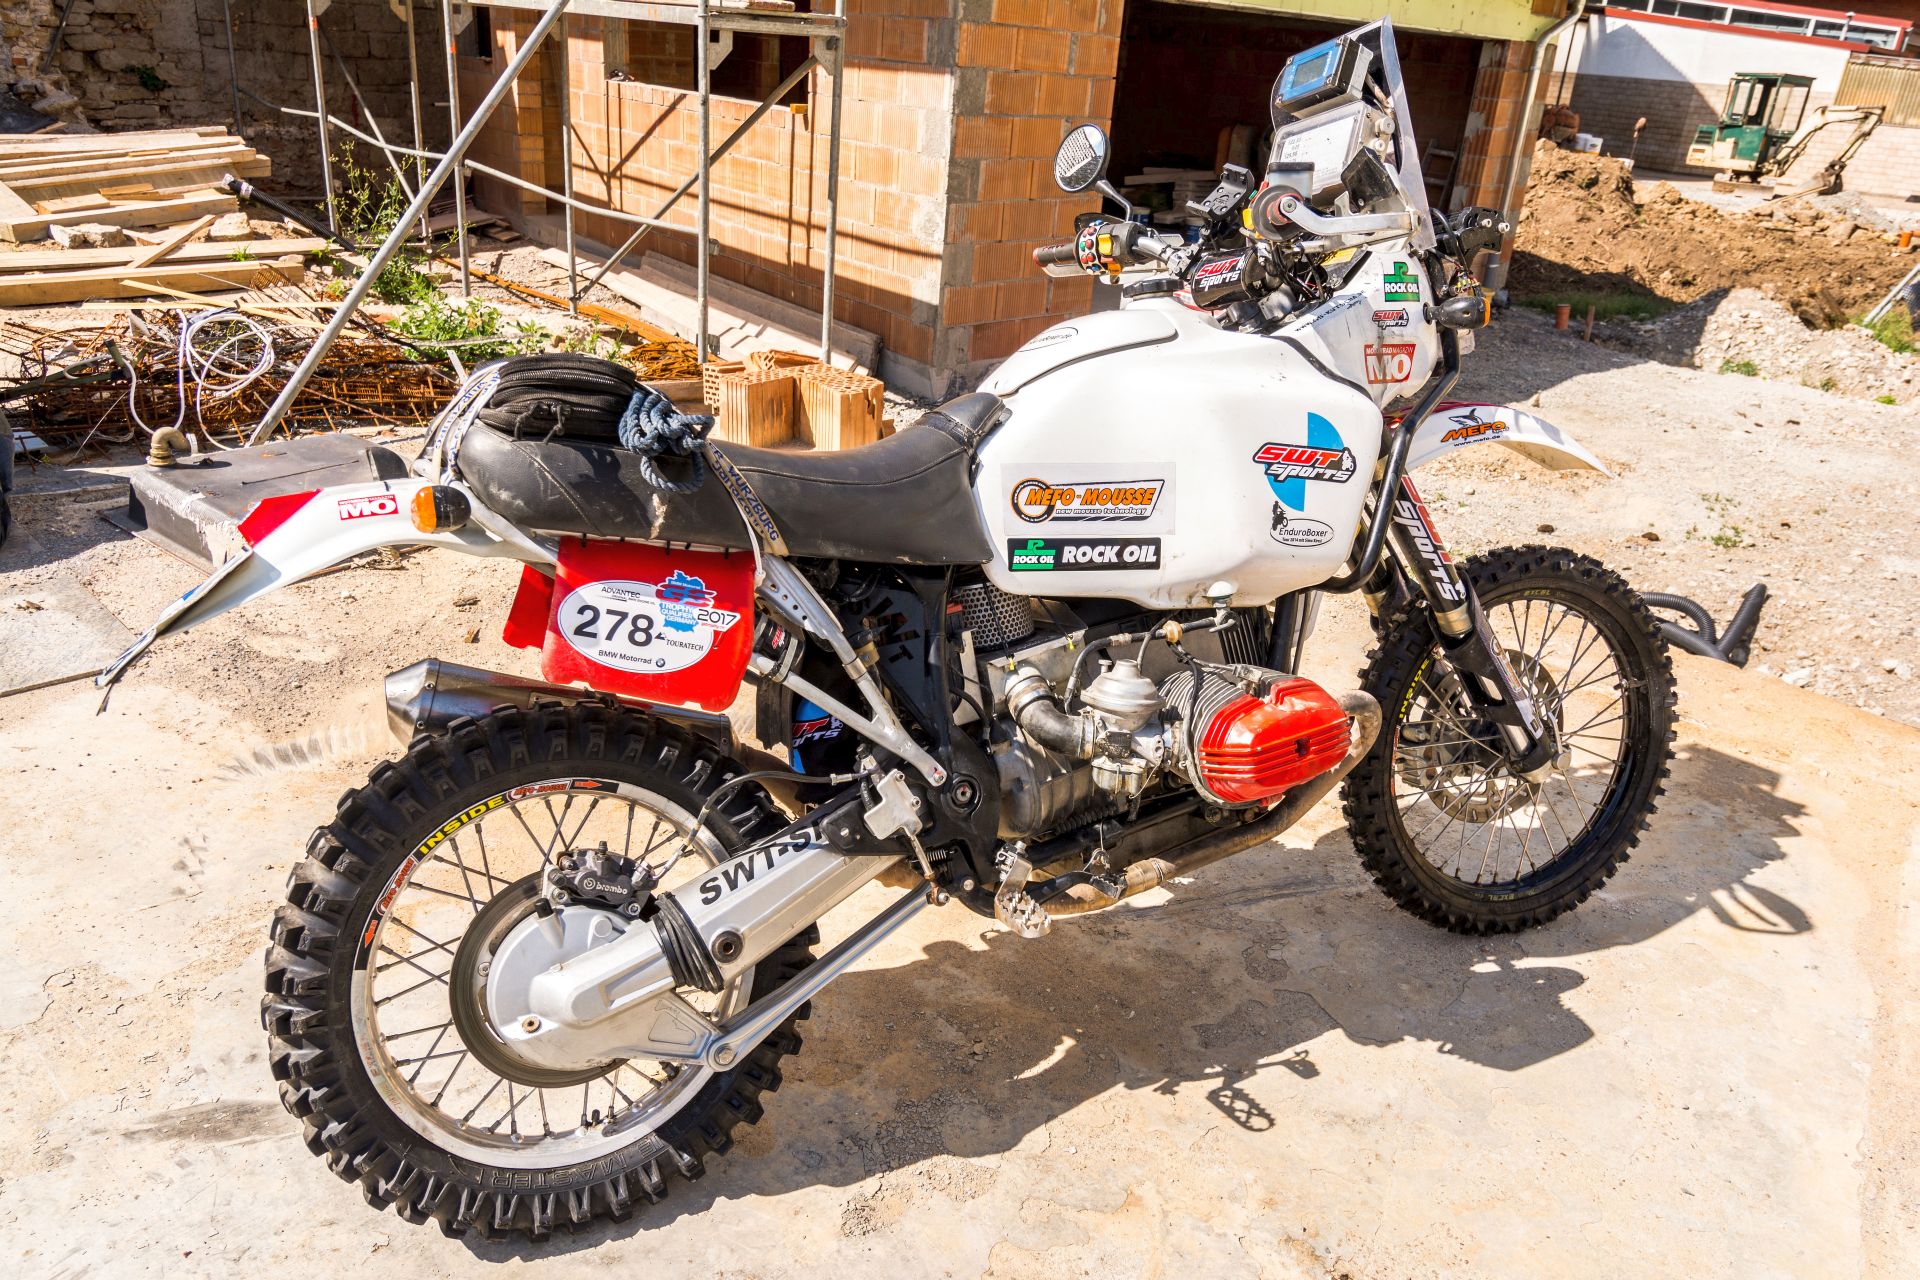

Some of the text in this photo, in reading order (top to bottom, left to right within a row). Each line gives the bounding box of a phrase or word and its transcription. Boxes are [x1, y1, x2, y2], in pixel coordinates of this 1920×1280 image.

[1196, 258, 1240, 279] SWT
[1384, 283, 1420, 294] ROCK OIL
[1373, 311, 1403, 321] SWT
[1366, 354, 1412, 381] MO
[1440, 420, 1507, 444] MEFO
[1256, 444, 1343, 468] SWT
[1267, 463, 1352, 482] sports
[339, 500, 397, 519] MO
[1103, 506, 1148, 516] technology
[1278, 527, 1329, 538] EnduroBoxer
[1013, 555, 1055, 564] ROCK OIL
[1061, 544, 1158, 564] ROCK OIL
[600, 585, 641, 599] ADVANTEC
[661, 602, 694, 613] TROPHY
[661, 609, 693, 620] QUALIFIER
[665, 615, 697, 625] GERMANY
[697, 608, 738, 626] 2017
[573, 604, 655, 648] 278
[666, 639, 704, 652] TOURATECH
[598, 649, 653, 665] BMW Motorrad
[1398, 658, 1430, 719] INSIDE
[419, 795, 505, 855] INSIDE
[595, 881, 628, 896] brembo
[490, 1152, 627, 1190] MASTER
